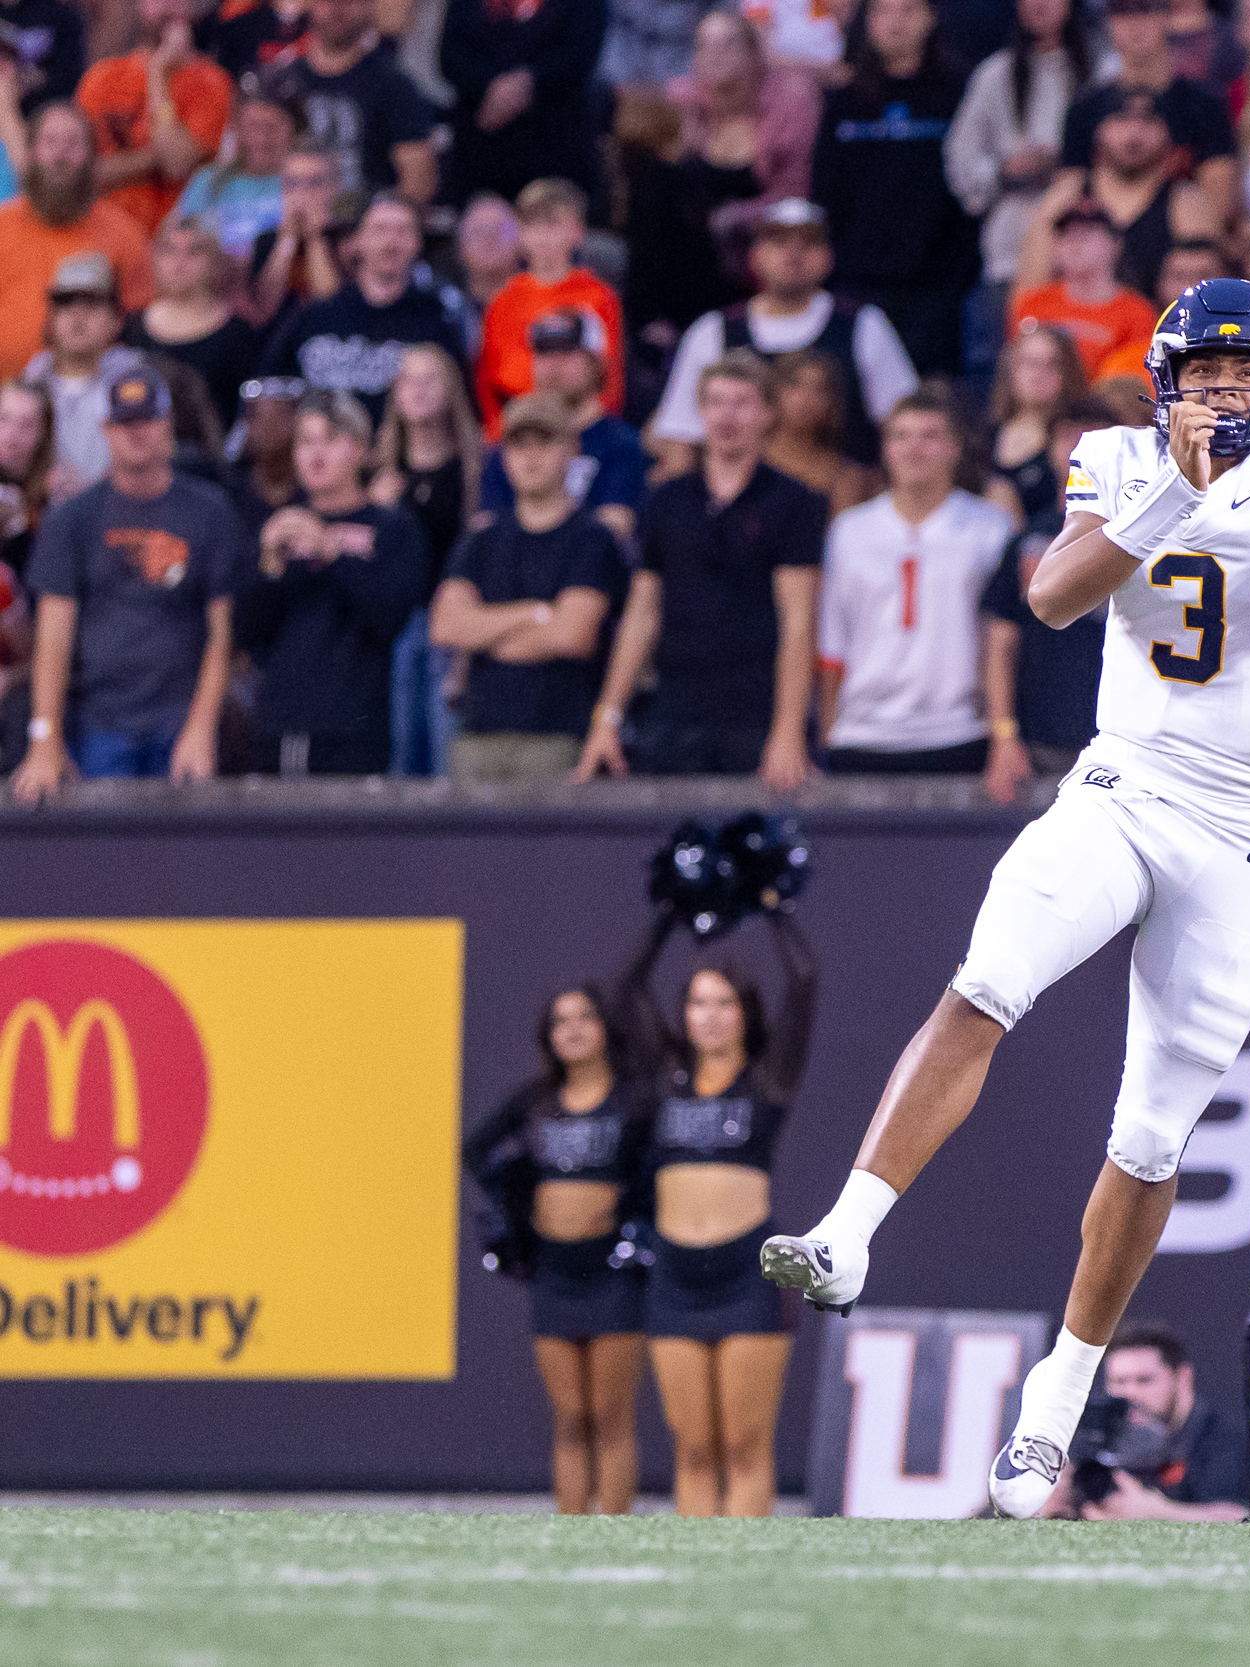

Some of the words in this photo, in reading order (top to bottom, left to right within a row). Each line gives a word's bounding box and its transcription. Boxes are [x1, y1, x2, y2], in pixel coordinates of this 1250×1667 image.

[1149, 552, 1227, 686] 3
[1080, 767, 1121, 789] Cal
[845, 1330, 1020, 1519] U
